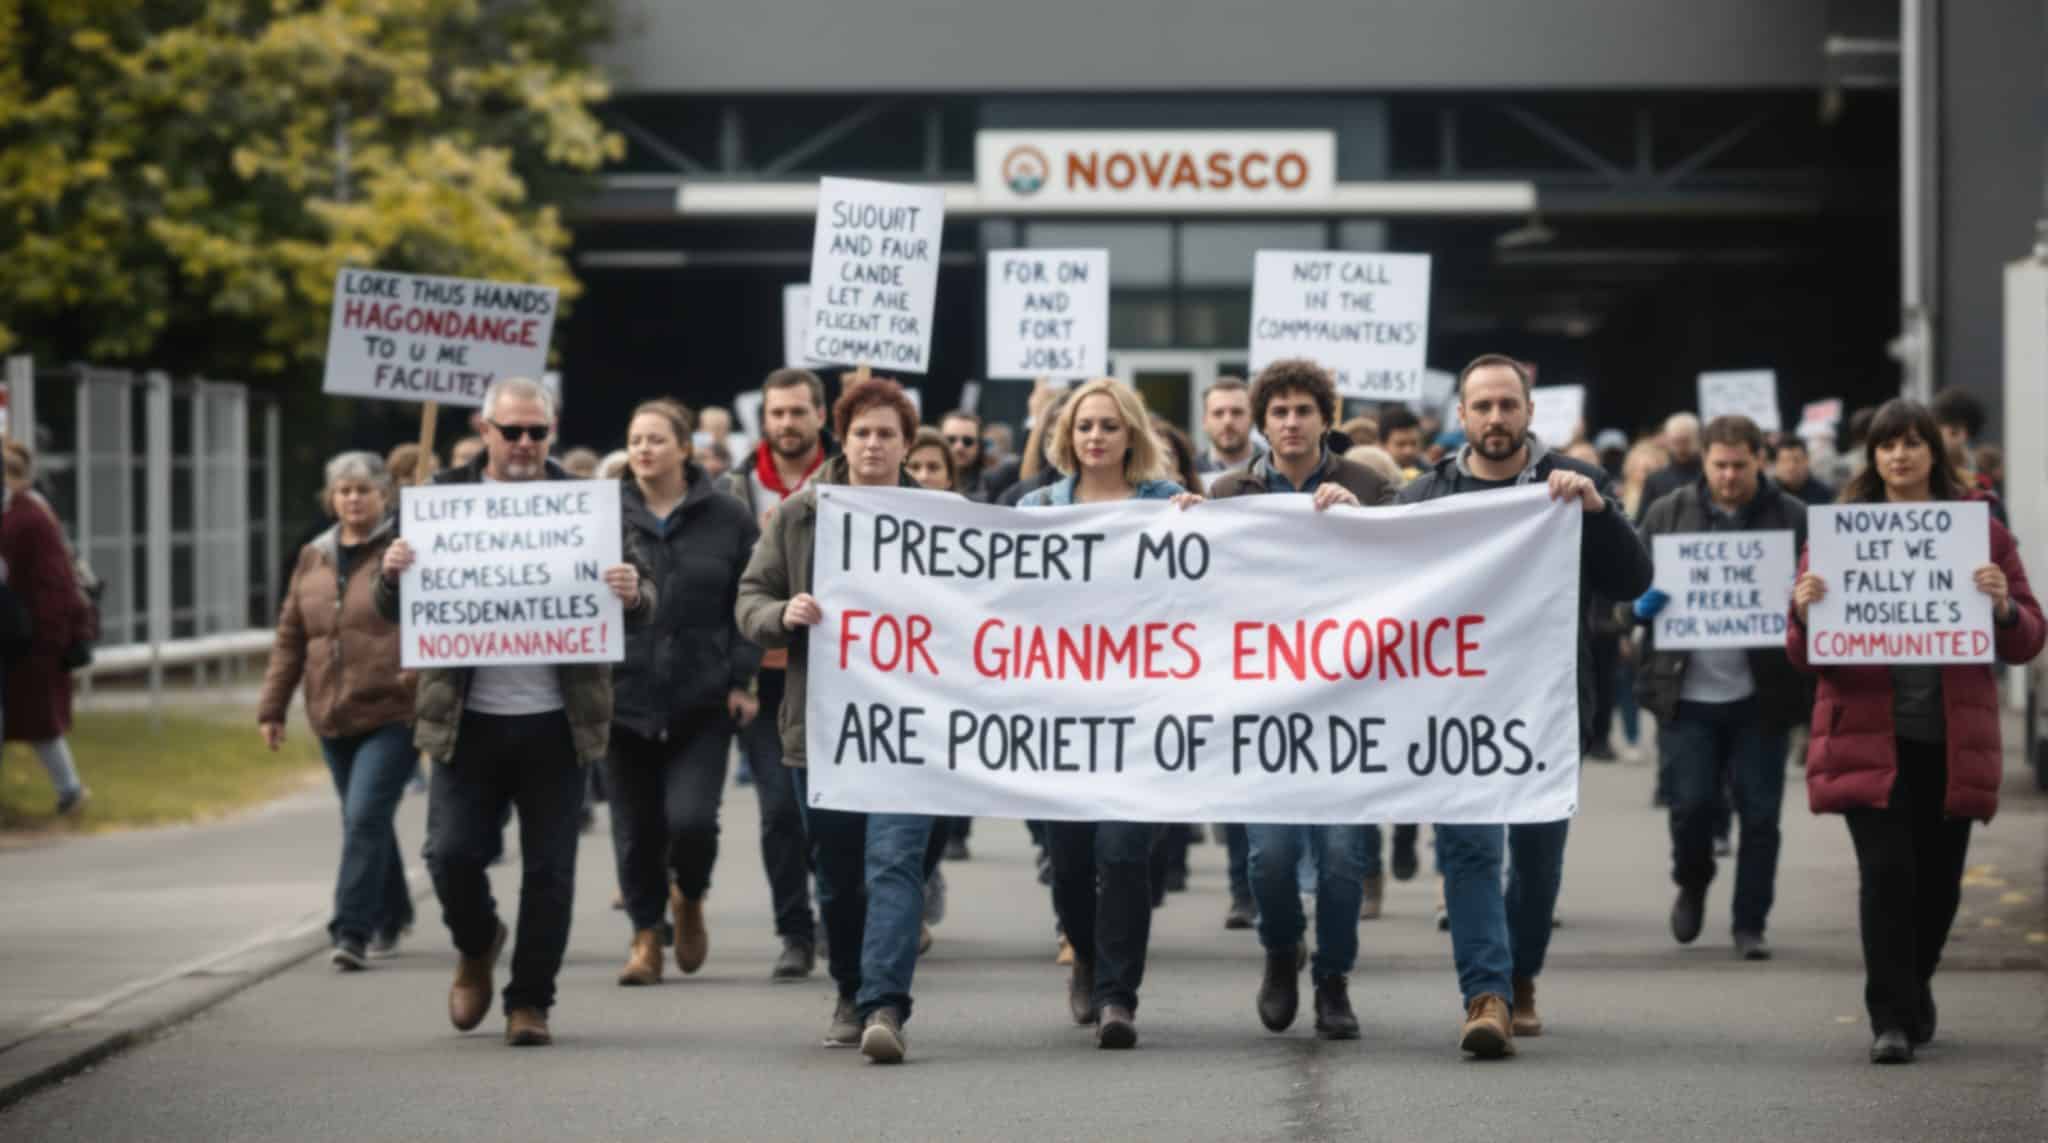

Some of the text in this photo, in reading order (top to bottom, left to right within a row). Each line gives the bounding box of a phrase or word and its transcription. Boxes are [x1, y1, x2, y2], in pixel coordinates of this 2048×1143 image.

[1067, 150, 1310, 191] NOVASCO
[831, 234, 872, 256] AND
[841, 262, 903, 286] CANDE
[1004, 261, 1089, 284] FOR ON
[1293, 263, 1391, 285] NOT CALL
[473, 287, 550, 314] HANDS
[828, 286, 862, 305] LET
[1024, 292, 1071, 313] AND
[1306, 291, 1374, 312] IN THE
[344, 301, 539, 347] HAGONDANGE
[890, 318, 918, 335] FOR
[1020, 318, 1074, 339] FORT
[364, 336, 396, 357] TO
[1835, 510, 1952, 534] NOVASCO
[841, 512, 1210, 582] I PRESPERT MO
[1738, 540, 1764, 559] US
[1856, 538, 1936, 560] LET WE
[575, 561, 599, 581] IN
[1690, 565, 1756, 584] IN THE
[1844, 569, 1953, 592] FALLY IN
[1664, 612, 1786, 637] FOR WANTED
[838, 610, 1487, 681] FOR GIANMES ENCORICE
[1814, 630, 1990, 657] COMMUNITED
[833, 702, 926, 767] ARE
[947, 708, 1135, 772] PORIETT
[1155, 713, 1213, 772] OF
[1407, 713, 1548, 776] JOBS.
